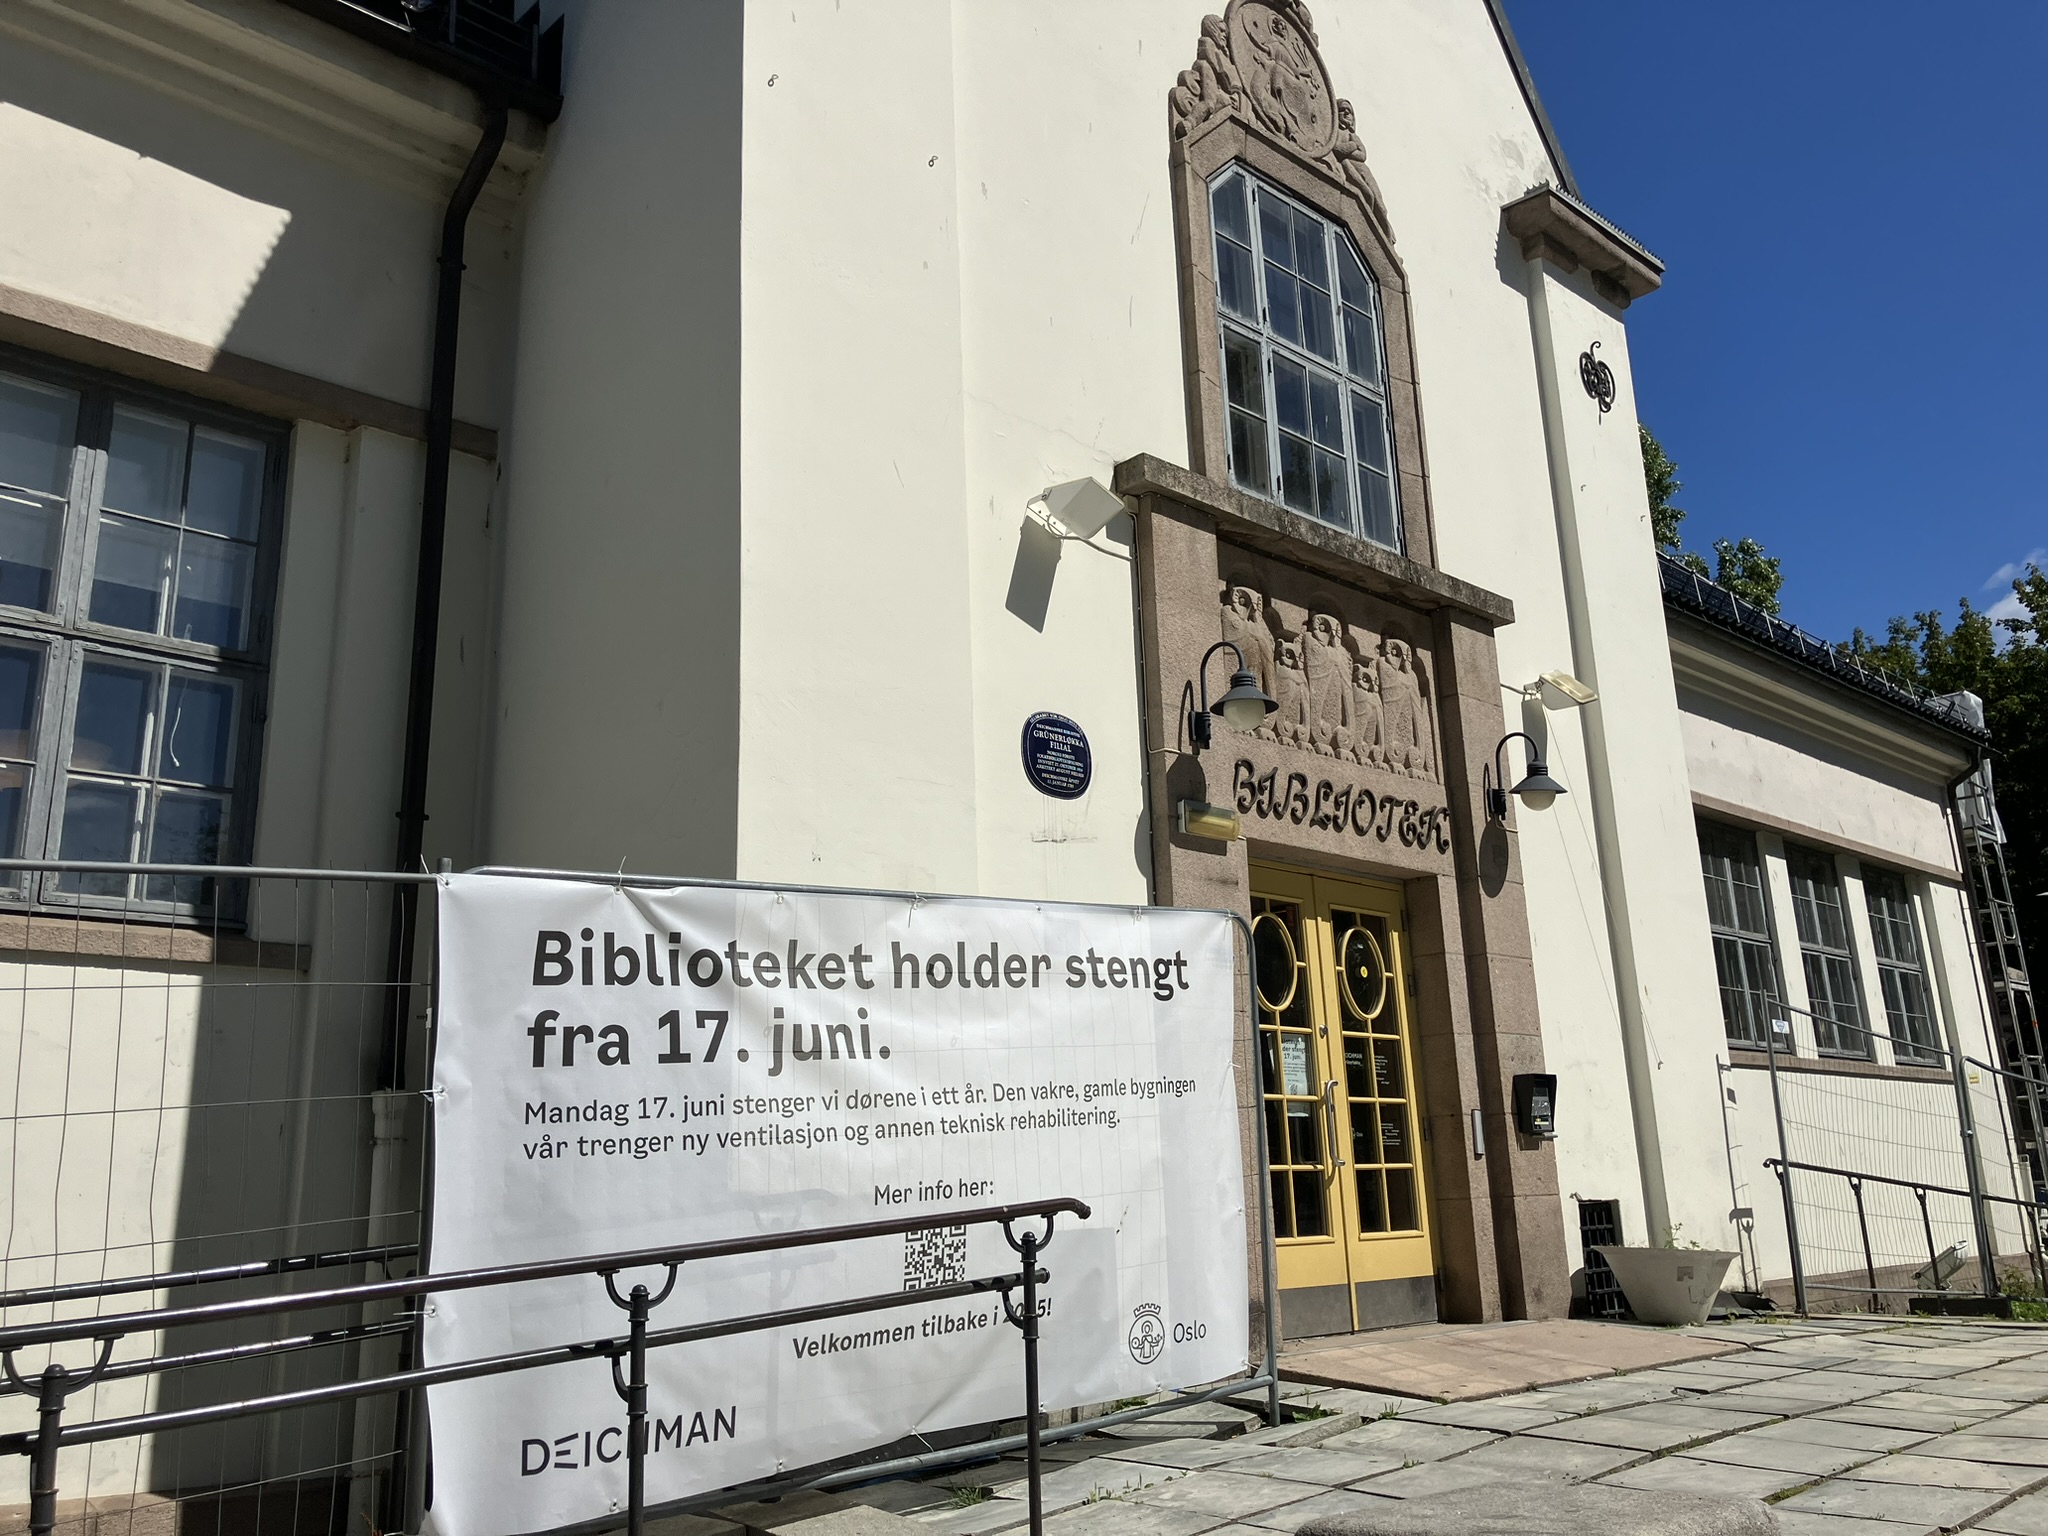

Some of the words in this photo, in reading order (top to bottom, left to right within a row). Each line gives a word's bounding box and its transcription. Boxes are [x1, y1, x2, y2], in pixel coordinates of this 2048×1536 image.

[1033, 729, 1084, 748] GRÜNERLØKKA
[1050, 741, 1072, 752] FILIAL
[1232, 757, 1451, 855] BIBLIOTEK
[533, 927, 874, 989] Biblioteket
[891, 942, 1051, 989] holder
[1066, 948, 1189, 1001] stengt
[527, 1010, 630, 1067] fra
[658, 1010, 749, 1064] 17.
[768, 1007, 890, 1076] juni.
[525, 1100, 629, 1126] Mandag
[639, 1097, 674, 1119] 17.
[682, 1094, 724, 1123] juni
[733, 1095, 815, 1118] stenger
[822, 1090, 838, 1110] vi
[846, 1089, 916, 1110] dørene
[921, 1087, 926, 1105] i
[932, 1087, 959, 1105] ett
[965, 1083, 986, 1103] år.
[993, 1084, 1025, 1102] Den
[1031, 1081, 1078, 1102] vakre,
[1084, 1079, 1126, 1102] gamle
[1131, 1076, 1195, 1099] bygningen
[523, 1134, 568, 1159] vår
[577, 1136, 673, 1159] trenger
[683, 1134, 709, 1155] ny
[717, 1122, 837, 1148] ventilasjon
[845, 1125, 869, 1145] og
[875, 1121, 934, 1139] annen
[940, 1113, 1005, 1134] teknisk
[1011, 1106, 1120, 1130] rehabilitering.
[875, 1185, 912, 1205] Mer
[919, 1180, 952, 1201] info
[960, 1179, 993, 1197] her:
[792, 1324, 915, 1358] Velkommen
[922, 1311, 987, 1337] tilbake
[993, 1306, 998, 1325] i
[1003, 1298, 1051, 1323] 05!
[1174, 1320, 1206, 1343] Oslo
